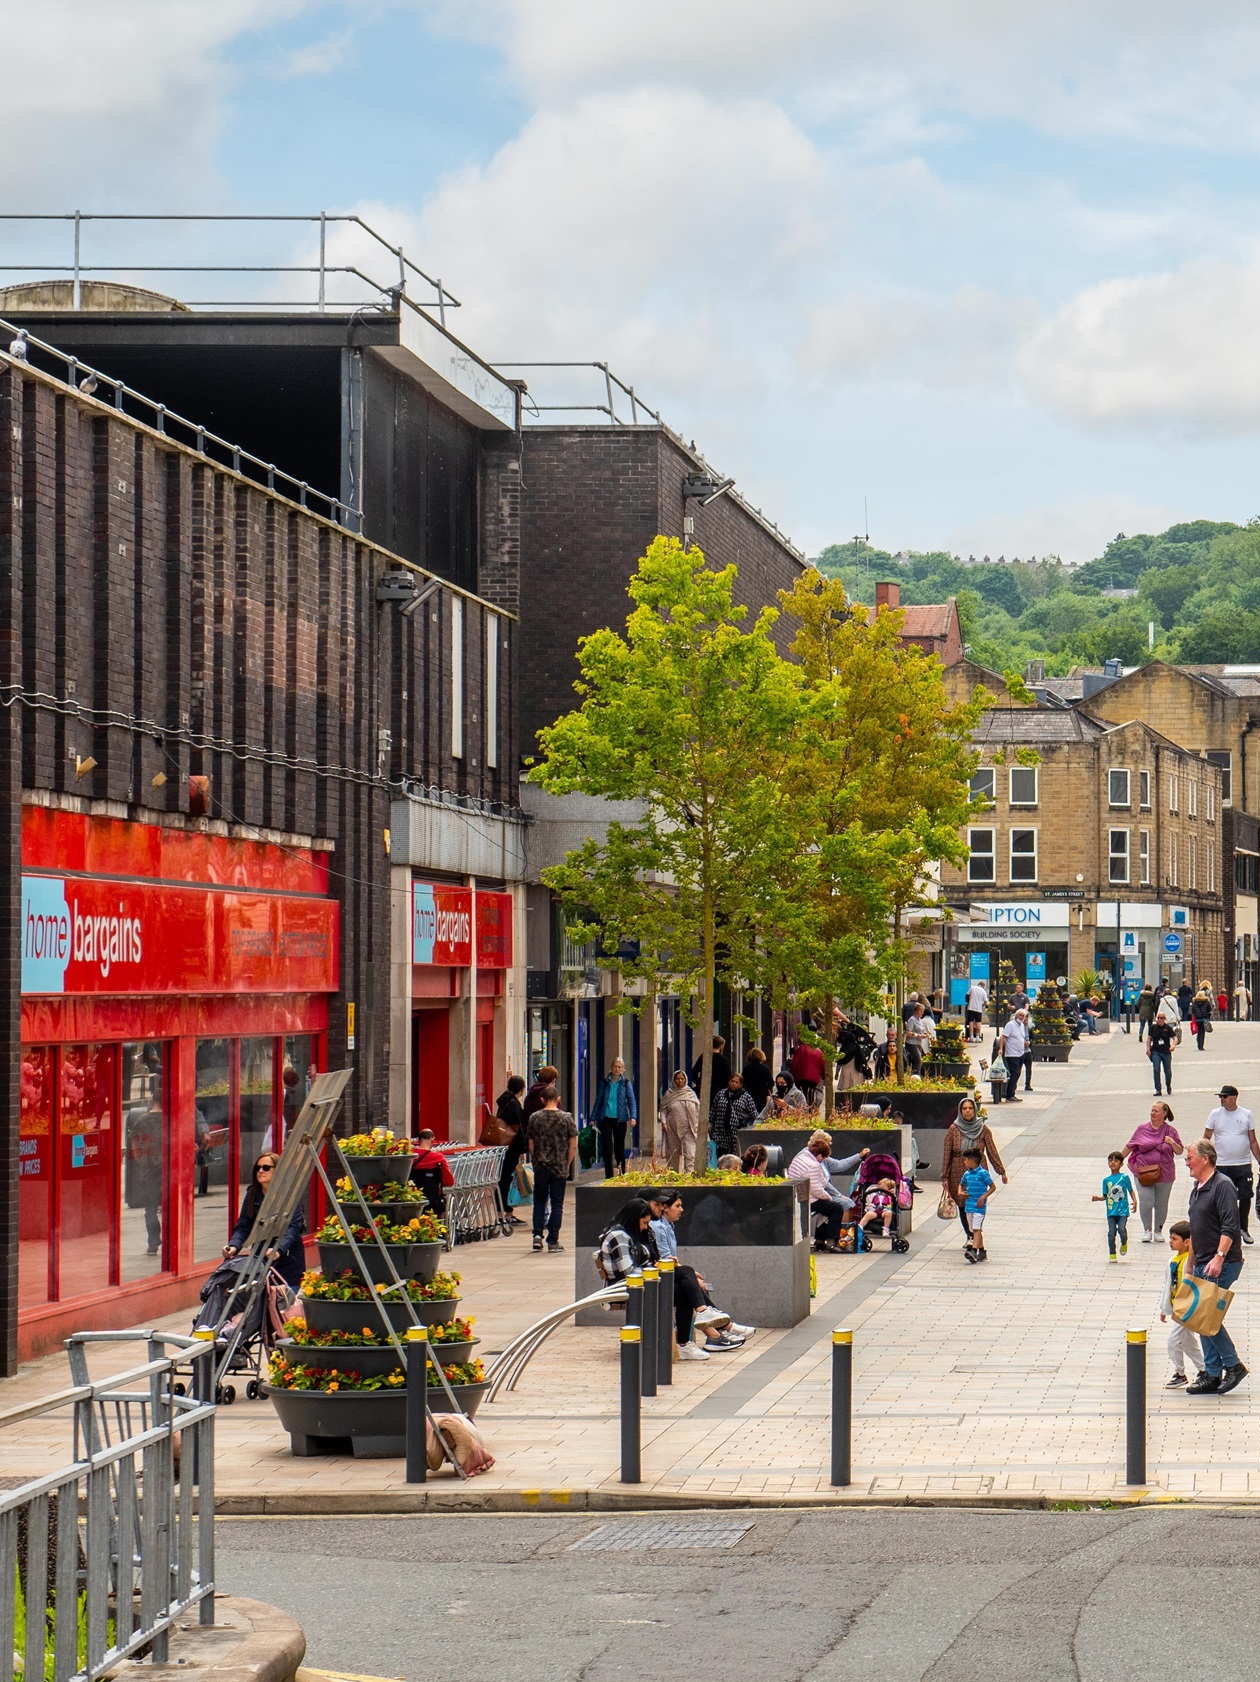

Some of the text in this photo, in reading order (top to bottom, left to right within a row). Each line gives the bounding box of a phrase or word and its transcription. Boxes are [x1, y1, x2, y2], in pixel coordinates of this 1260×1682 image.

[25, 898, 142, 978] home bargains
[415, 900, 435, 939] home
[436, 900, 470, 953] bargains
[972, 931, 1041, 939] BUILDING SOCIETY
